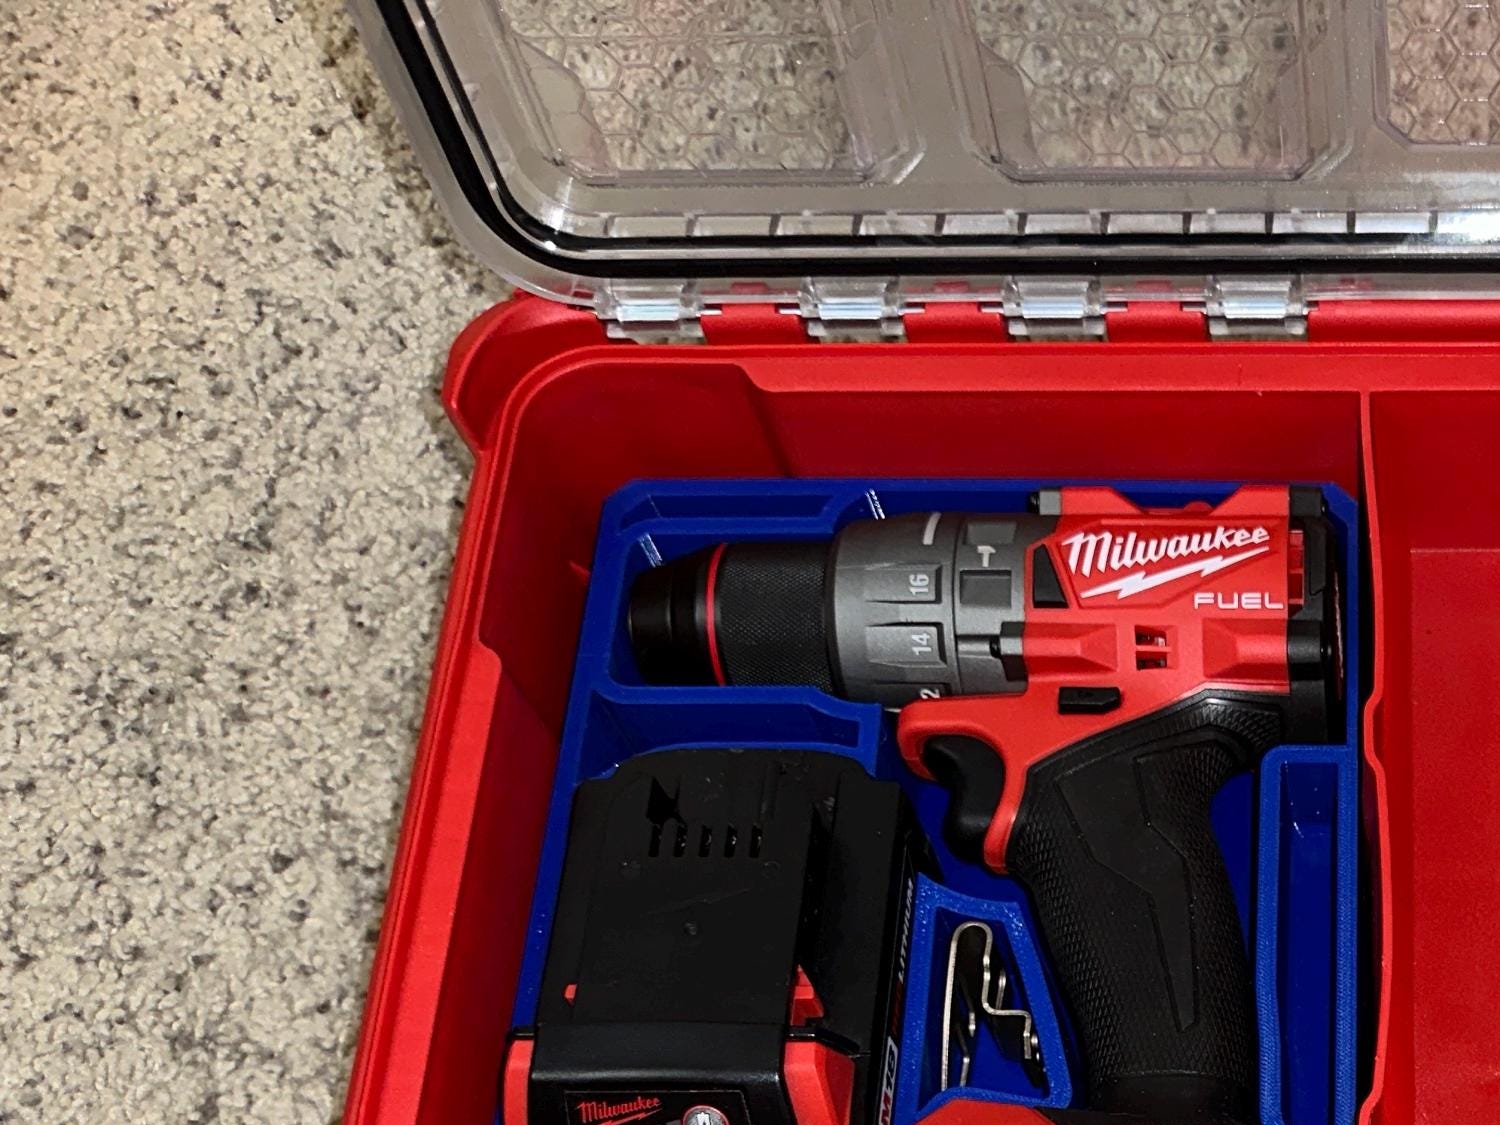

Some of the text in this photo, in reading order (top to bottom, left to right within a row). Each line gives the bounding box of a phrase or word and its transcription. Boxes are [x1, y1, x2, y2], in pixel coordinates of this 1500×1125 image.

[1061, 525, 1271, 579] Milwaukee
[908, 573, 930, 597] 16
[1194, 592, 1285, 610] FUEL
[911, 632, 932, 656] 14
[577, 1096, 661, 1124] Milwaukee
